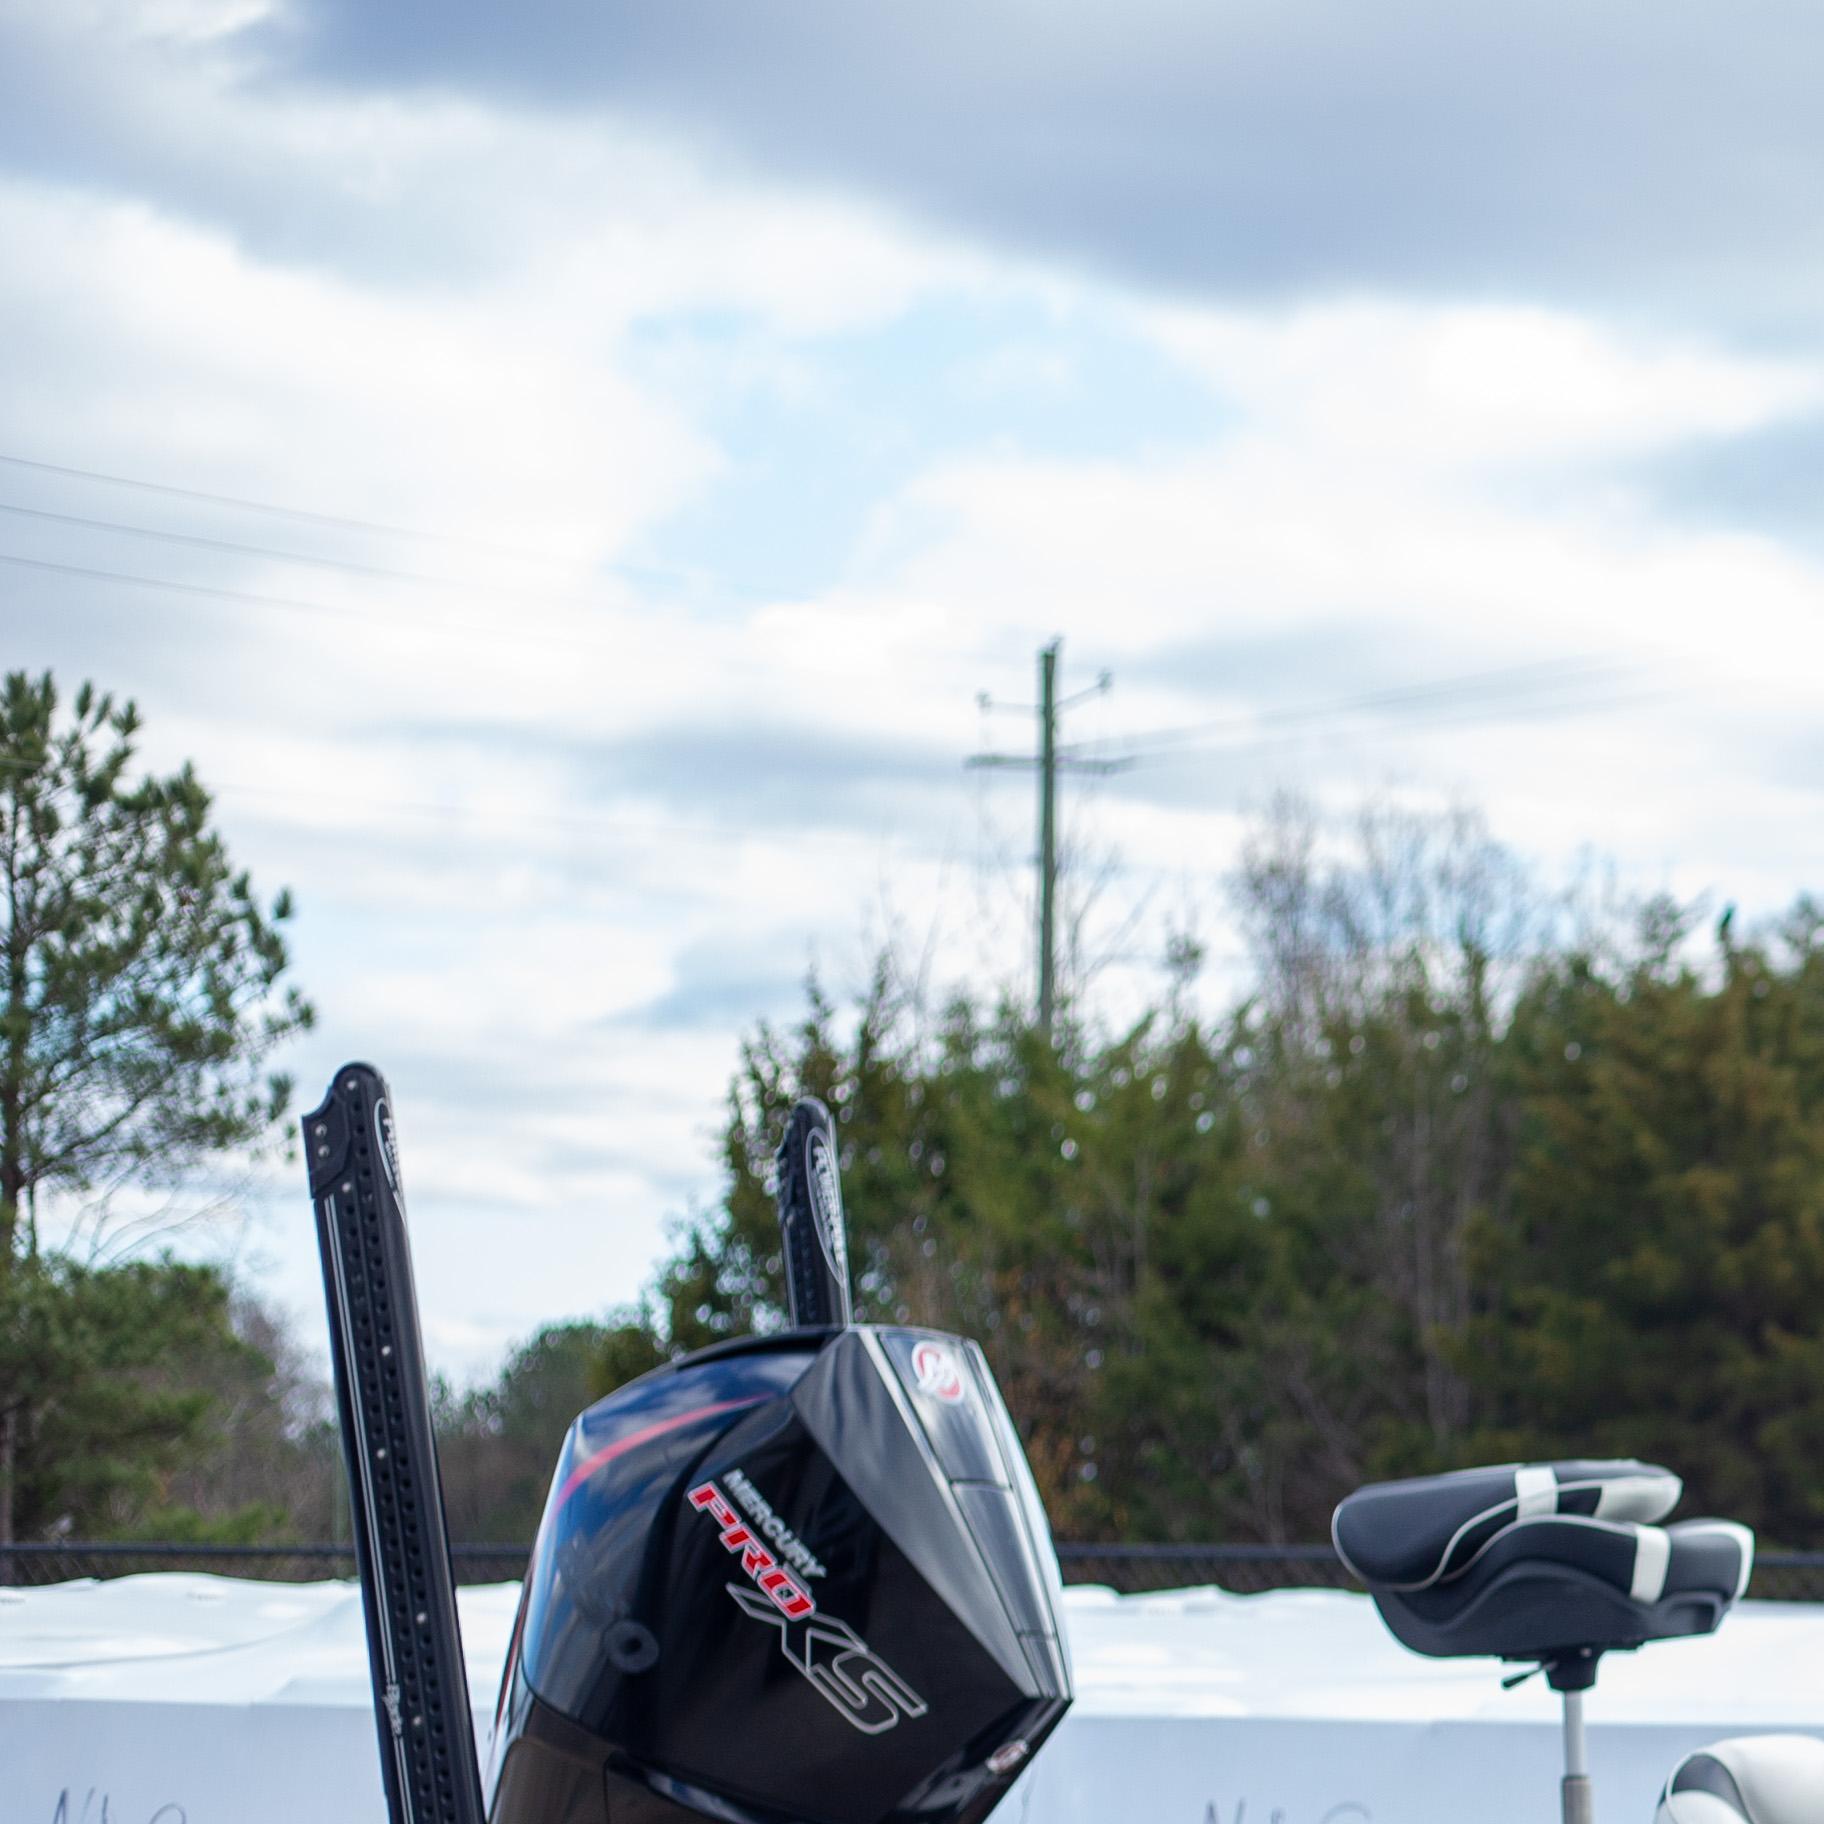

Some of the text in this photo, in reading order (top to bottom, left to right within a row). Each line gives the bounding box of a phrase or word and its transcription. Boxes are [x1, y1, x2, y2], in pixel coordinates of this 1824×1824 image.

[687, 1480, 815, 1621] PRO
[722, 1468, 827, 1578] MERCURY
[725, 1562, 929, 1735] XS
